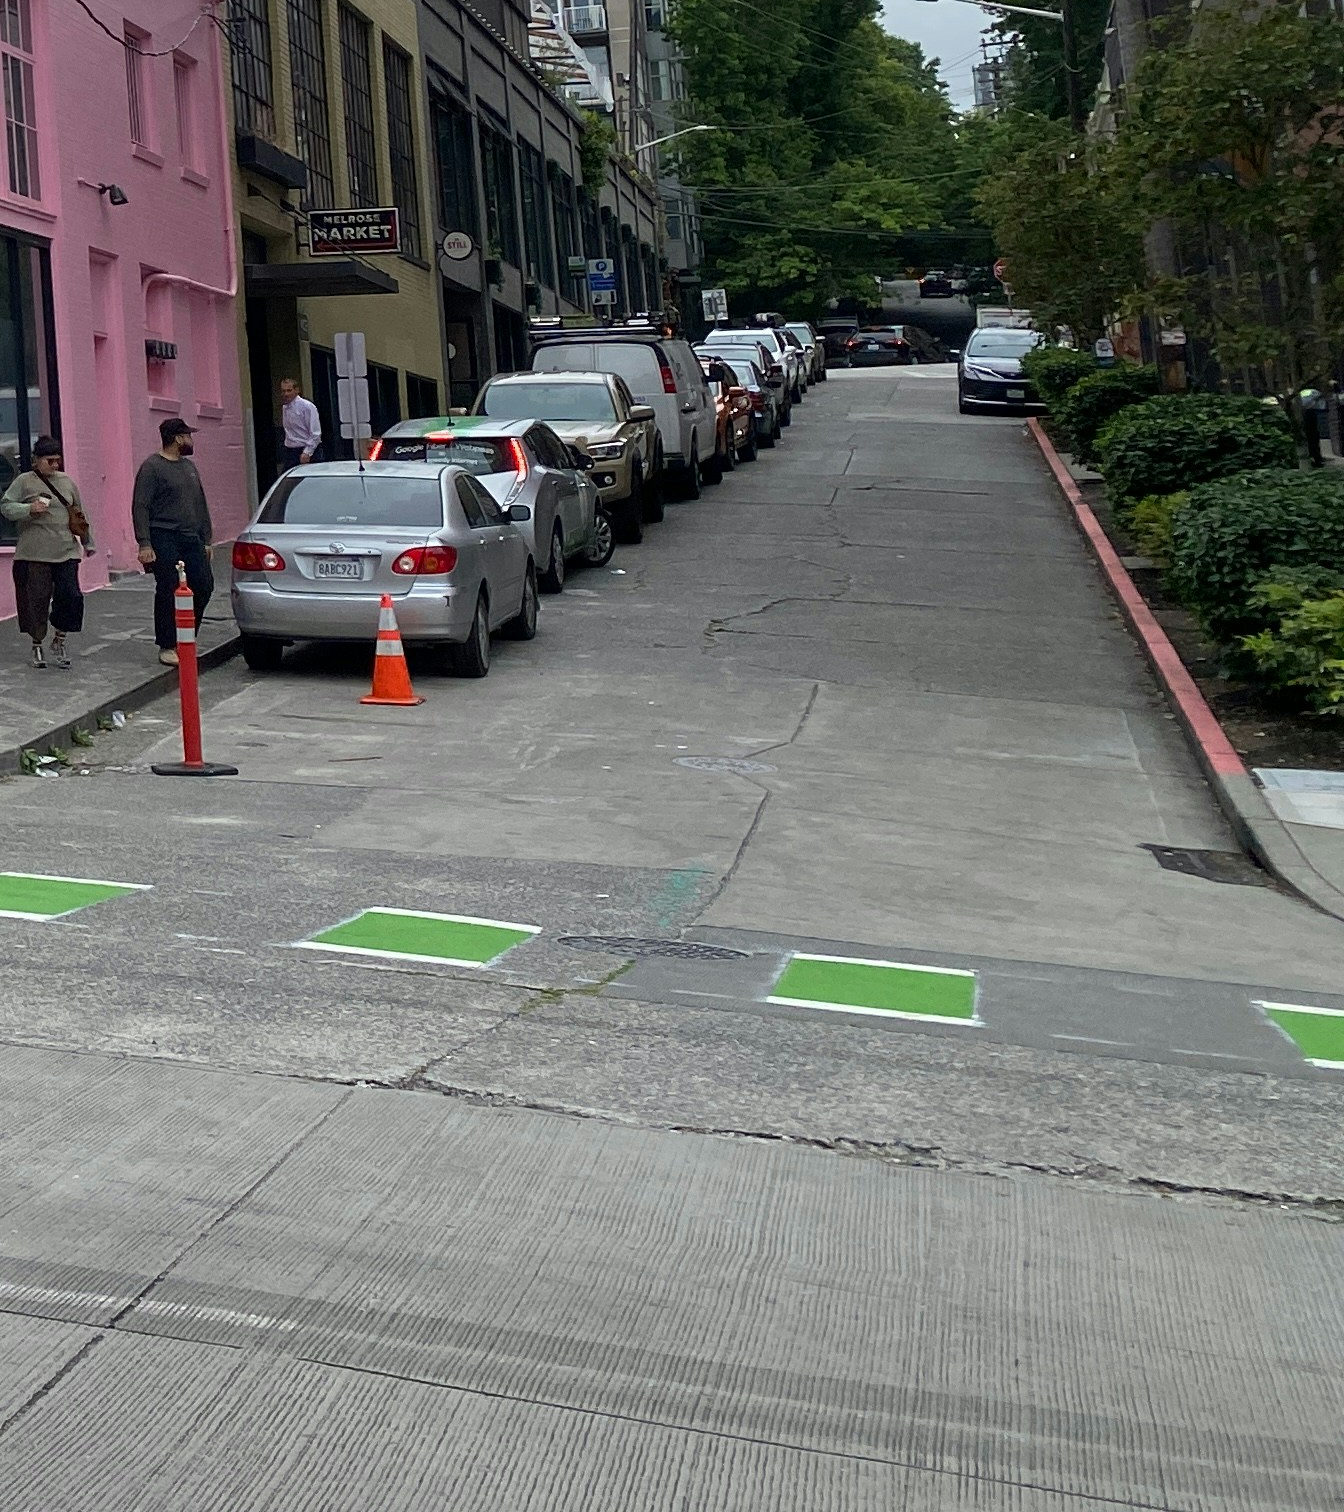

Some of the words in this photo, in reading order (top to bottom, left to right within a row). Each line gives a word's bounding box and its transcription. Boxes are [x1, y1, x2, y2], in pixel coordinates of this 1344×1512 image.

[323, 213, 381, 224] MELROSE
[313, 225, 392, 241] MARKET
[394, 444, 425, 454] Google
[318, 563, 358, 576] 8ABC921
